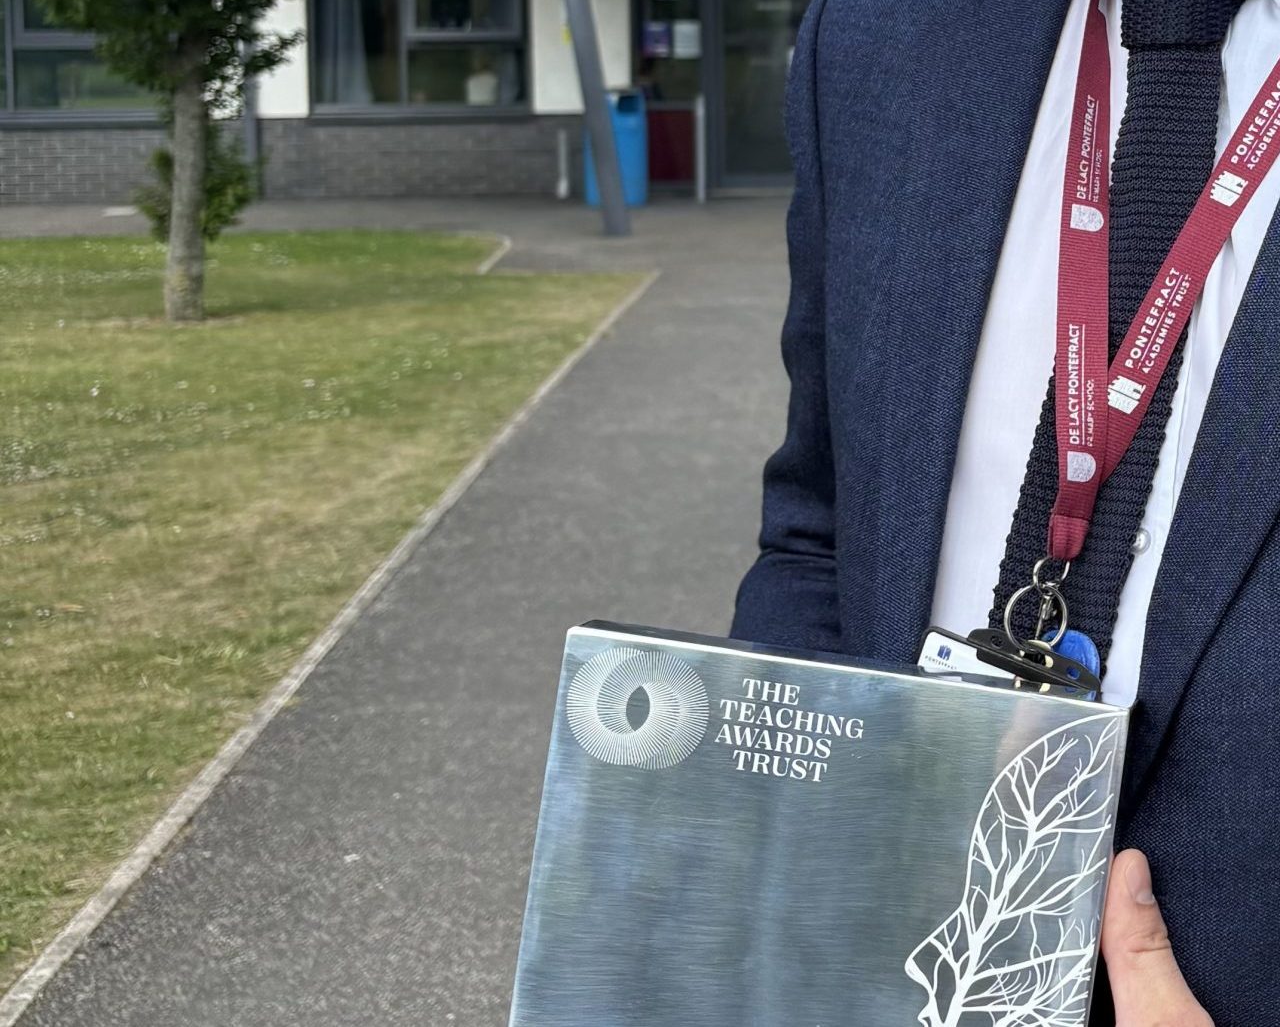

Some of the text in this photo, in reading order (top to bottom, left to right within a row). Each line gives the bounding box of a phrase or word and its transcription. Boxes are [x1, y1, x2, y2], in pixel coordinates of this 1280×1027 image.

[1076, 94, 1096, 200] DE LACY PONTEFRACT
[1124, 267, 1180, 369] PONTEFRACT
[1142, 311, 1176, 374] ACADEMIES
[1068, 323, 1080, 445] DE LACY PONTEFRACT
[742, 678, 801, 706] THE
[714, 723, 832, 759] AWARDS
[720, 699, 864, 739] TEACHING
[733, 749, 828, 782] TRUST
